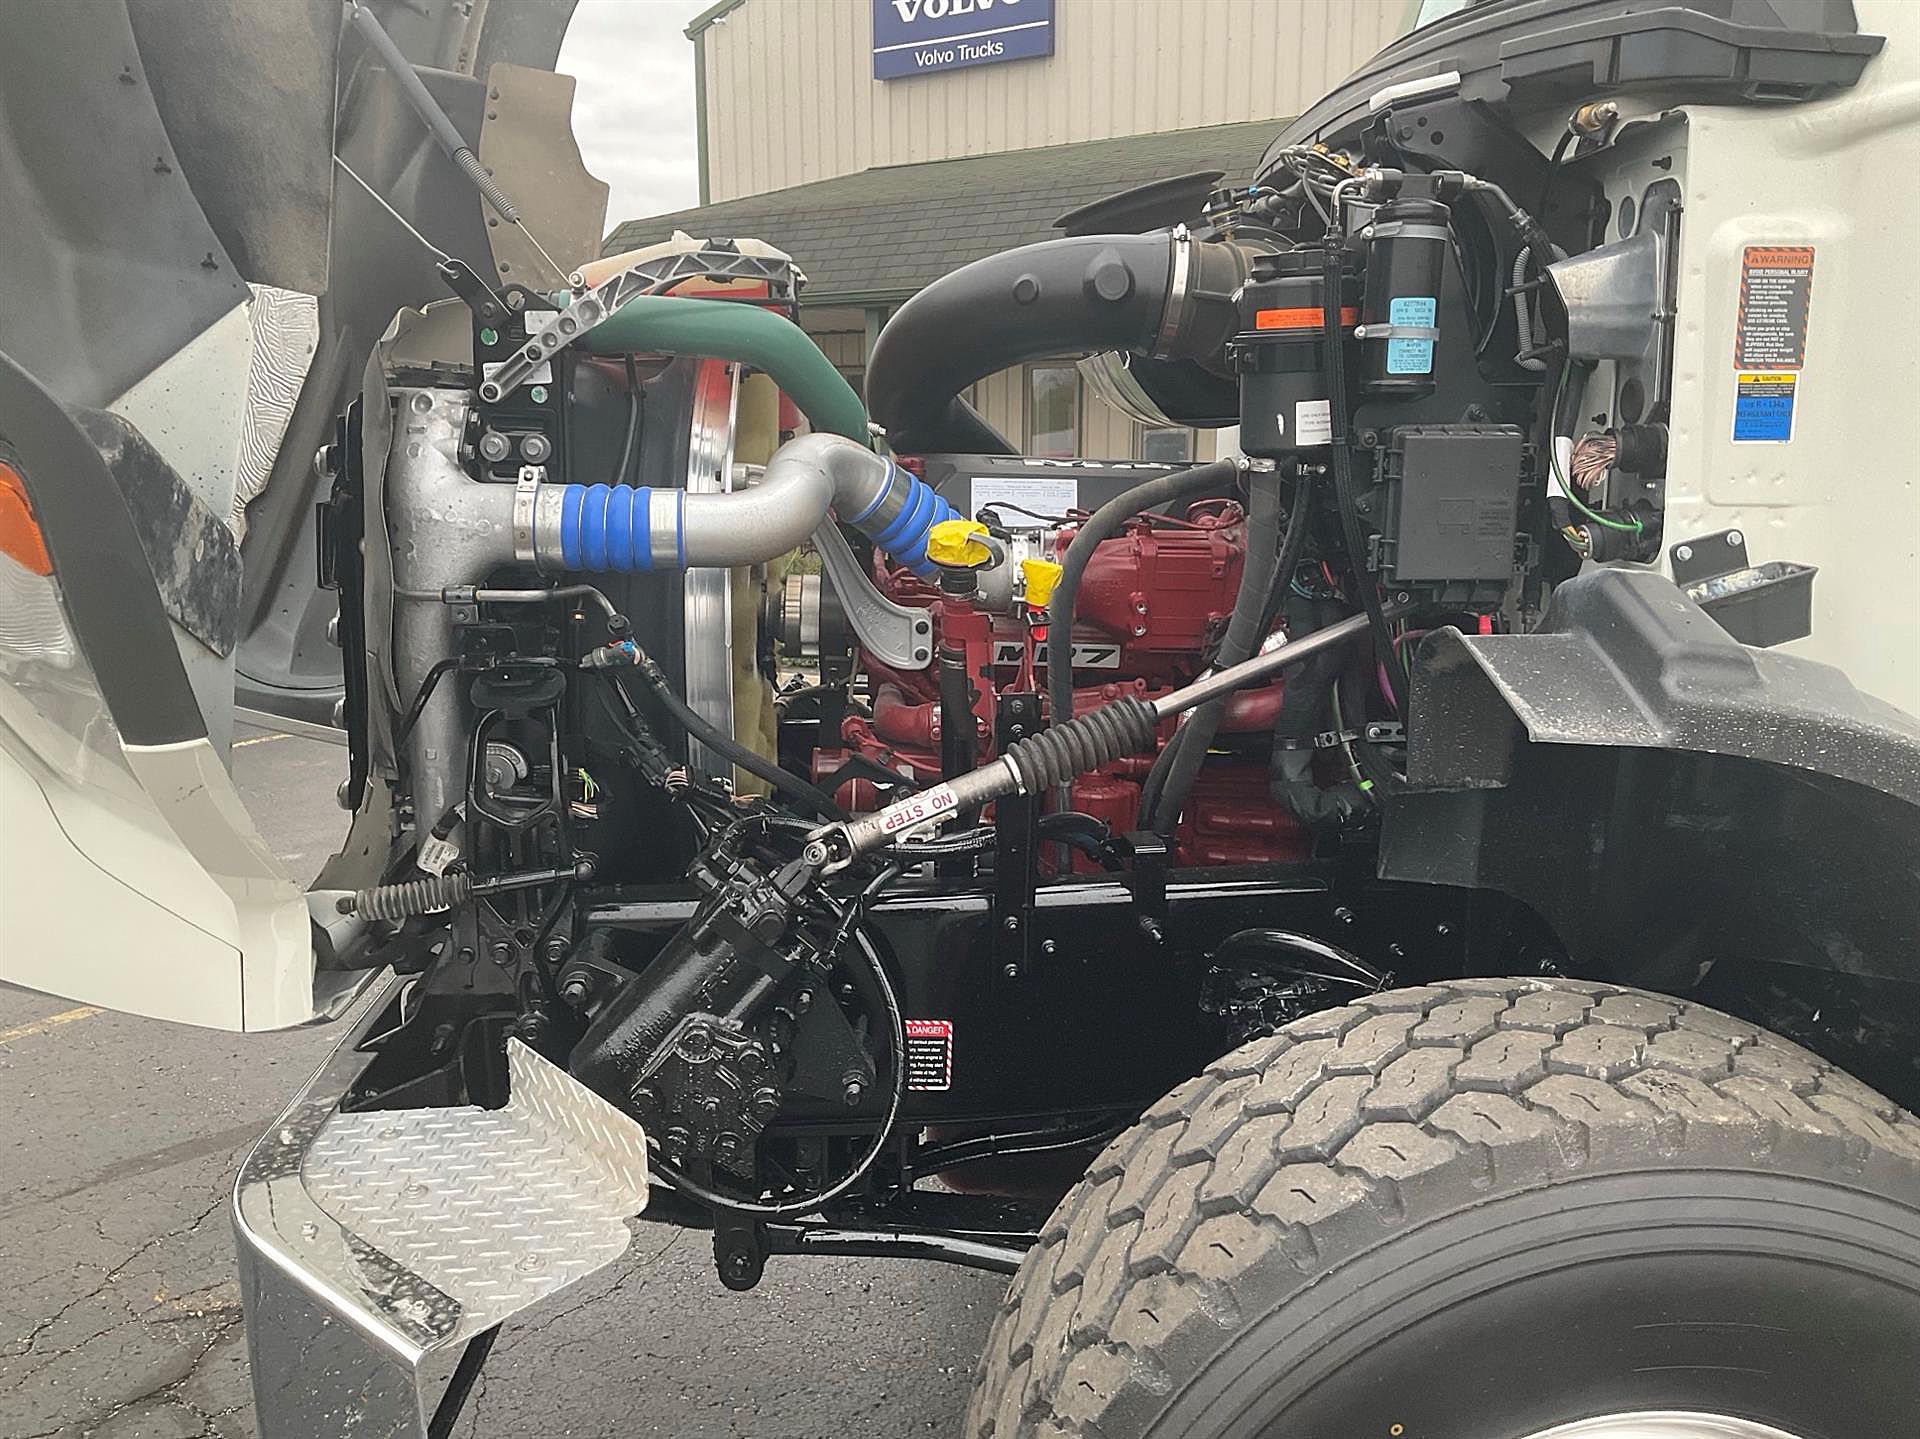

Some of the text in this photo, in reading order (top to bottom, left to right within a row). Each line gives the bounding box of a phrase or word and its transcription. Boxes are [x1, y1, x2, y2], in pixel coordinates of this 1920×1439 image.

[891, 0, 1022, 23] VOL
[915, 40, 1004, 67] Volvo Trucks
[1760, 255, 1809, 264] WARNING
[886, 793, 952, 829] NO STEP
[912, 1026, 944, 1034] DANGER
